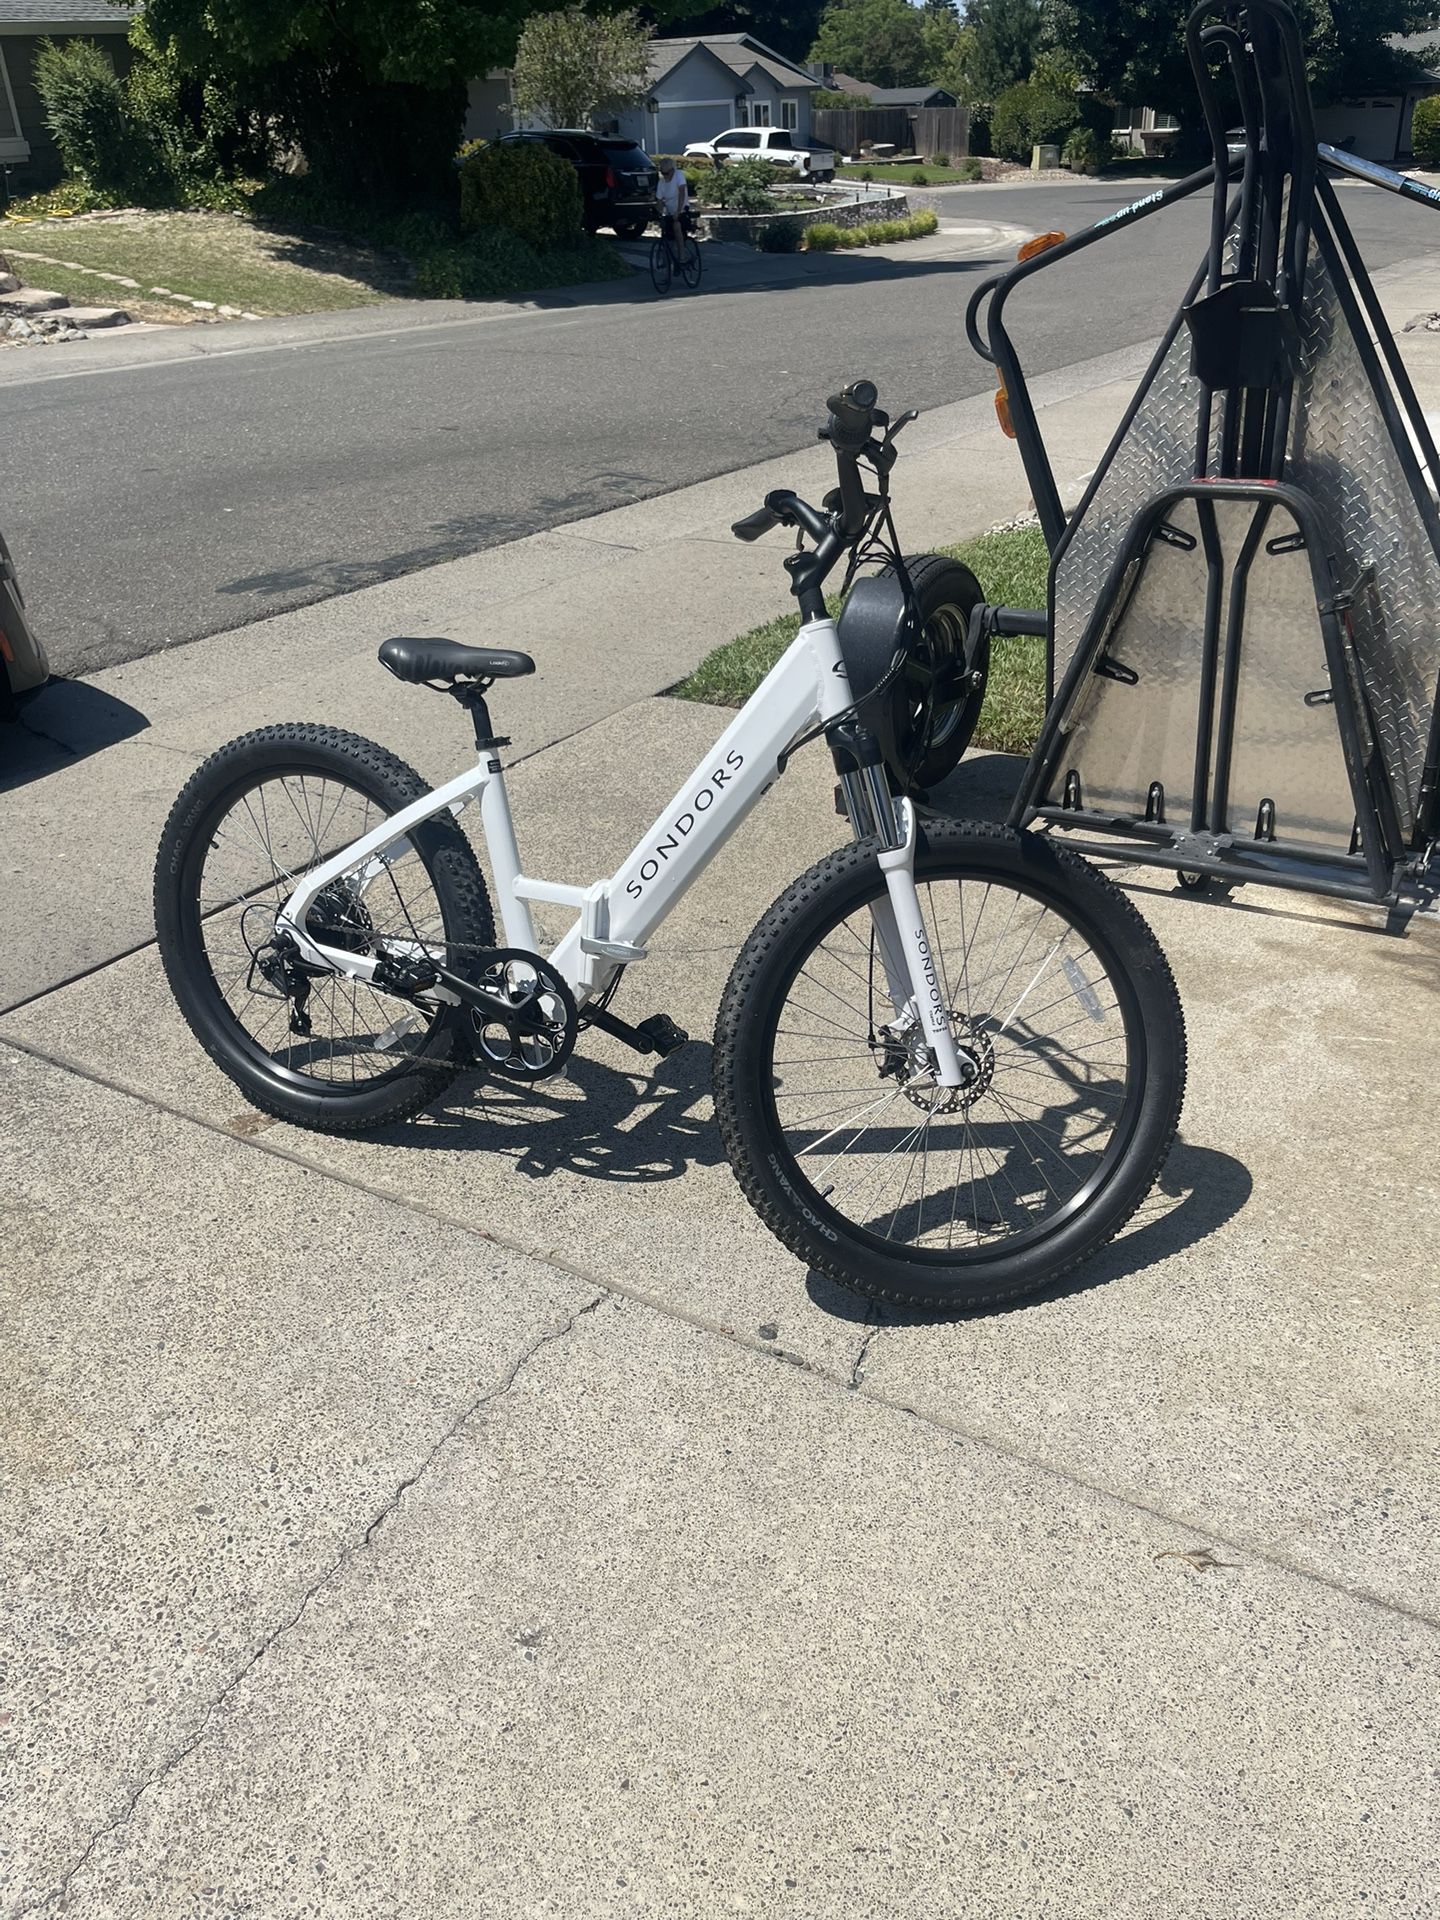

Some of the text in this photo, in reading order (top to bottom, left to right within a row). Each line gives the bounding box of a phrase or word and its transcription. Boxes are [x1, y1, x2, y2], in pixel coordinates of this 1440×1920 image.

[626, 749, 744, 899] SONDORS
[914, 929, 945, 1026] SONDORS
[768, 1153, 838, 1242] CHAO YANG
